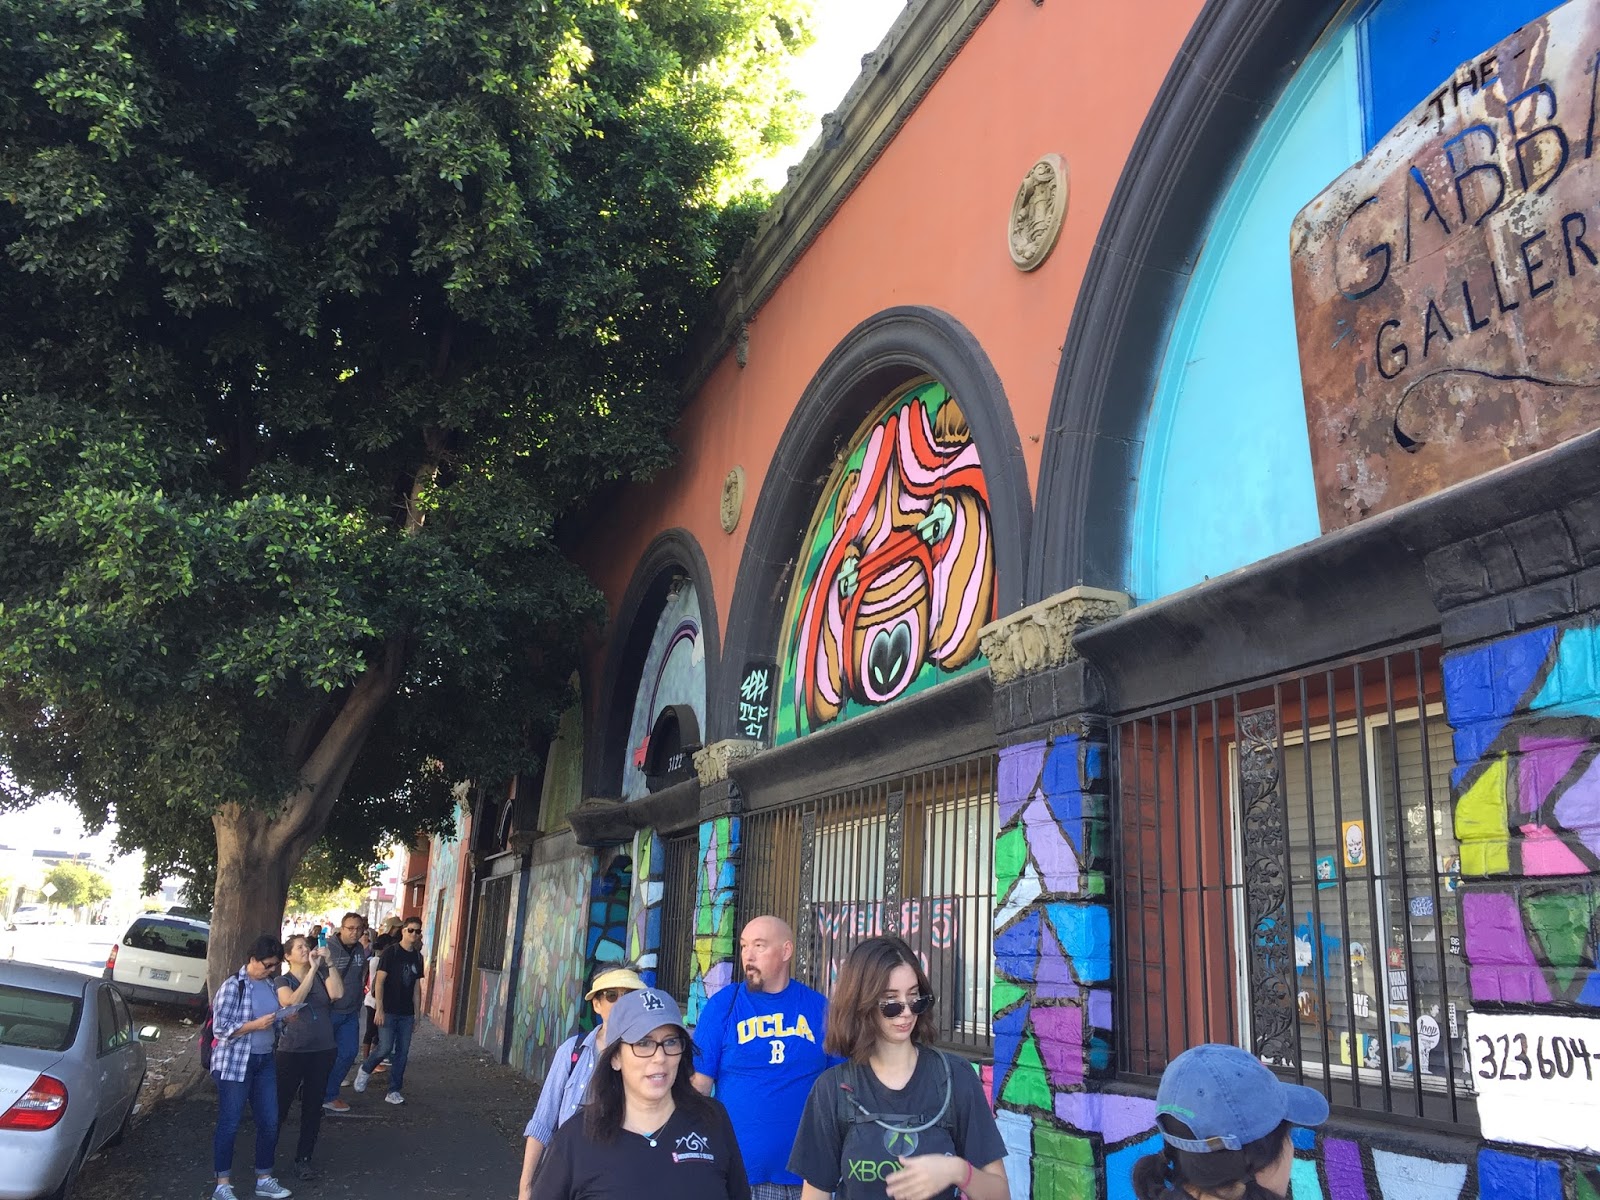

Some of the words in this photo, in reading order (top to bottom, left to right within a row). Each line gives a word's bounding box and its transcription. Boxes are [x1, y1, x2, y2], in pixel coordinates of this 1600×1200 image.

[639, 990, 665, 1012] LA
[736, 1012, 816, 1045] UCLA
[768, 1039, 786, 1065] B
